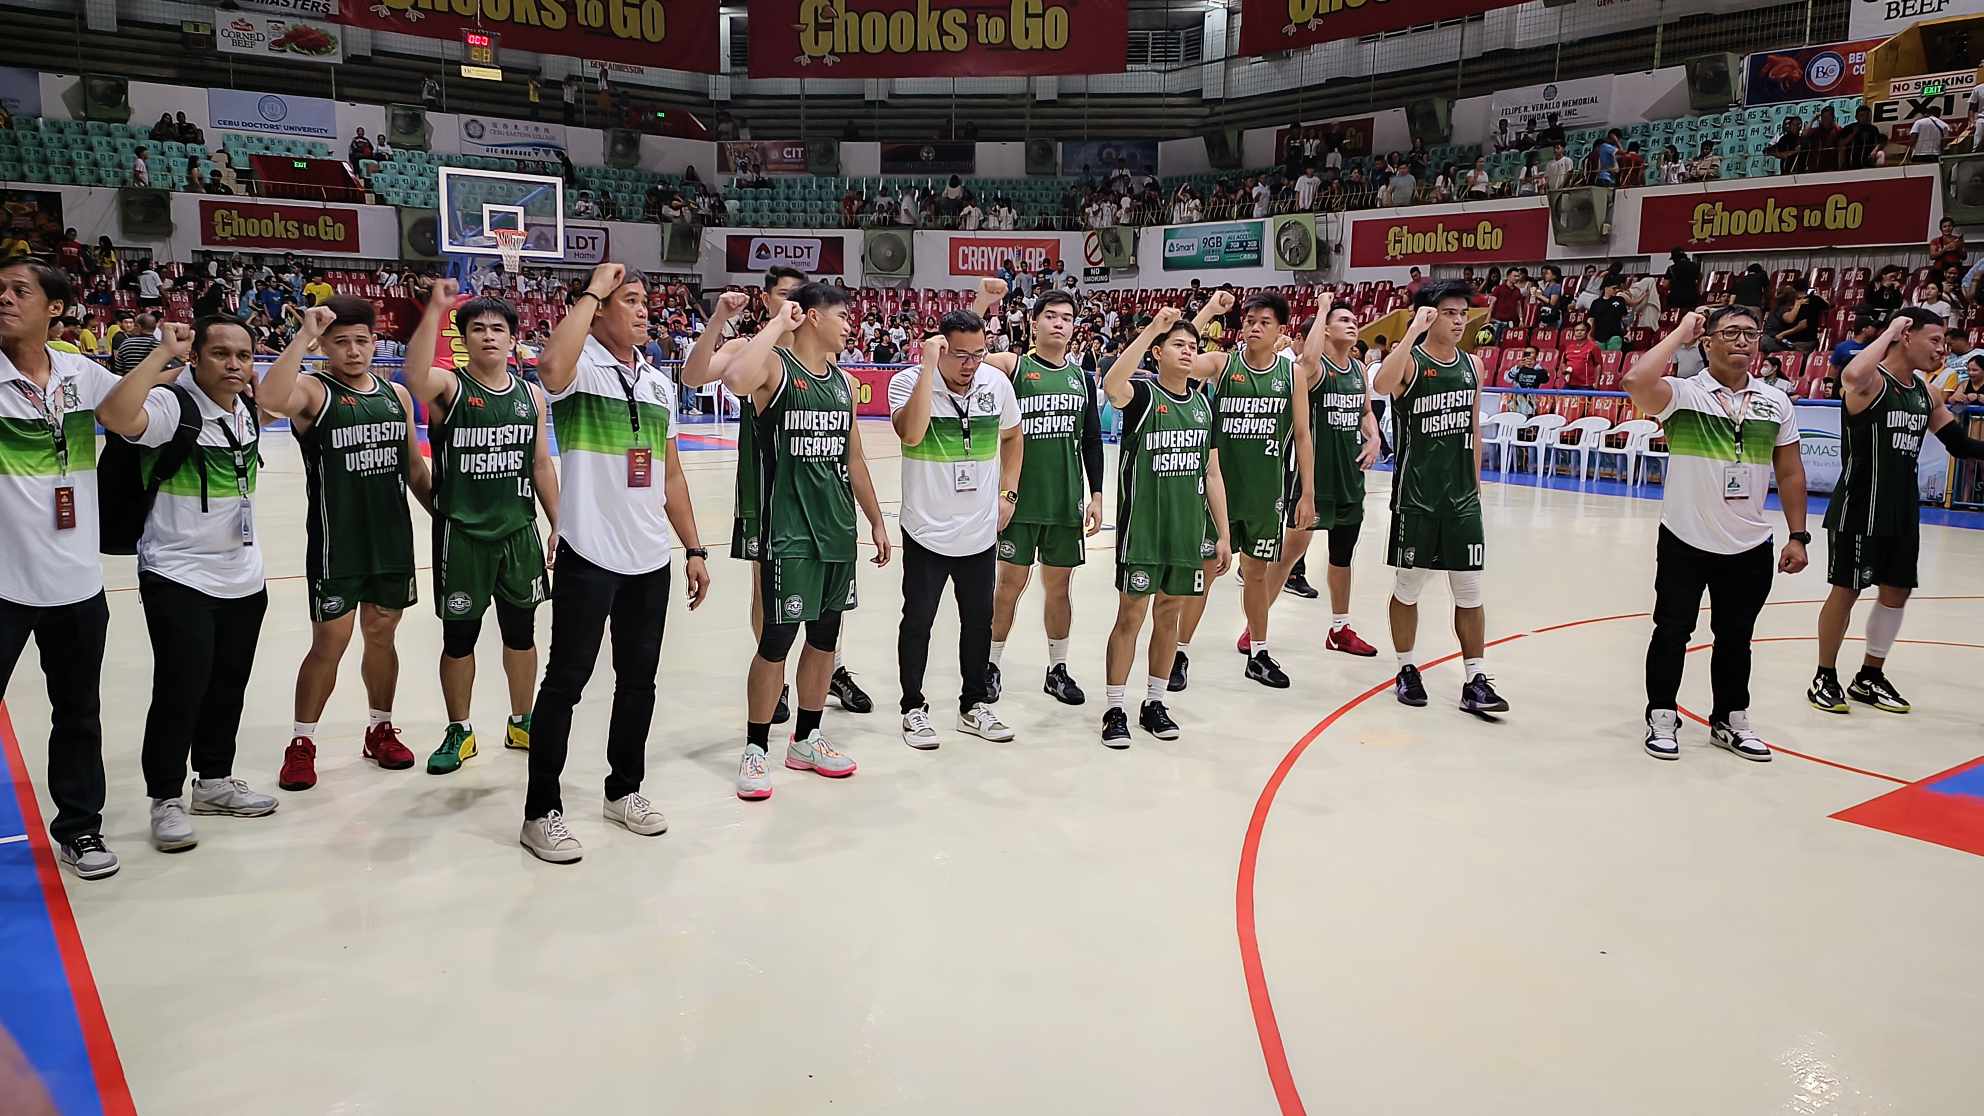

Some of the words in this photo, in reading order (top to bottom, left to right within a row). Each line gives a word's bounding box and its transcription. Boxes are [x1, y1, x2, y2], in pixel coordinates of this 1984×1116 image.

[608, 0, 667, 43] Go
[799, 0, 969, 57] Chooks
[976, 13, 1008, 46] to
[1010, 0, 1070, 51] Go
[221, 28, 265, 42] CORNED
[232, 39, 256, 49] BEEF
[1848, 53, 1867, 65] BEN
[1852, 66, 1866, 79] CO
[1892, 83, 1910, 94] NO
[1914, 75, 1974, 90] SMOKING
[1922, 86, 1944, 95] EXIT
[1501, 105, 1521, 116] FELIPE
[1531, 101, 1560, 112] VERALLO
[1561, 96, 1599, 109] MEMORIAL
[1873, 93, 1972, 122] EXI
[217, 119, 239, 128] CEBU
[283, 124, 328, 134] UNIVERSITY
[783, 147, 804, 159] CIT
[213, 209, 300, 240] Chooks
[303, 223, 318, 238] to
[318, 214, 346, 242] Go
[1692, 198, 1798, 240] Chooks
[1803, 207, 1823, 229] to
[1824, 193, 1864, 231] Go
[566, 236, 599, 251] LDT
[1175, 243, 1195, 253] Smart
[1202, 236, 1223, 249] 9GB
[1387, 222, 1459, 258] Chooks
[1461, 232, 1475, 249] to
[1476, 220, 1504, 251] Go
[573, 252, 596, 260] Home
[773, 245, 814, 259] PLDT
[1090, 267, 1101, 276] NO
[1018, 394, 1085, 414] NIVERSITY
[1219, 397, 1288, 415] UNIVERSITY
[331, 421, 406, 450] UNIVERSITY
[452, 424, 534, 449] UNIVERSITY
[1801, 443, 1841, 457] DMAS
[516, 477, 532, 498] 16
[1253, 538, 1277, 559] 25
[1466, 543, 1484, 567] 10
[1193, 569, 1205, 592] 8
